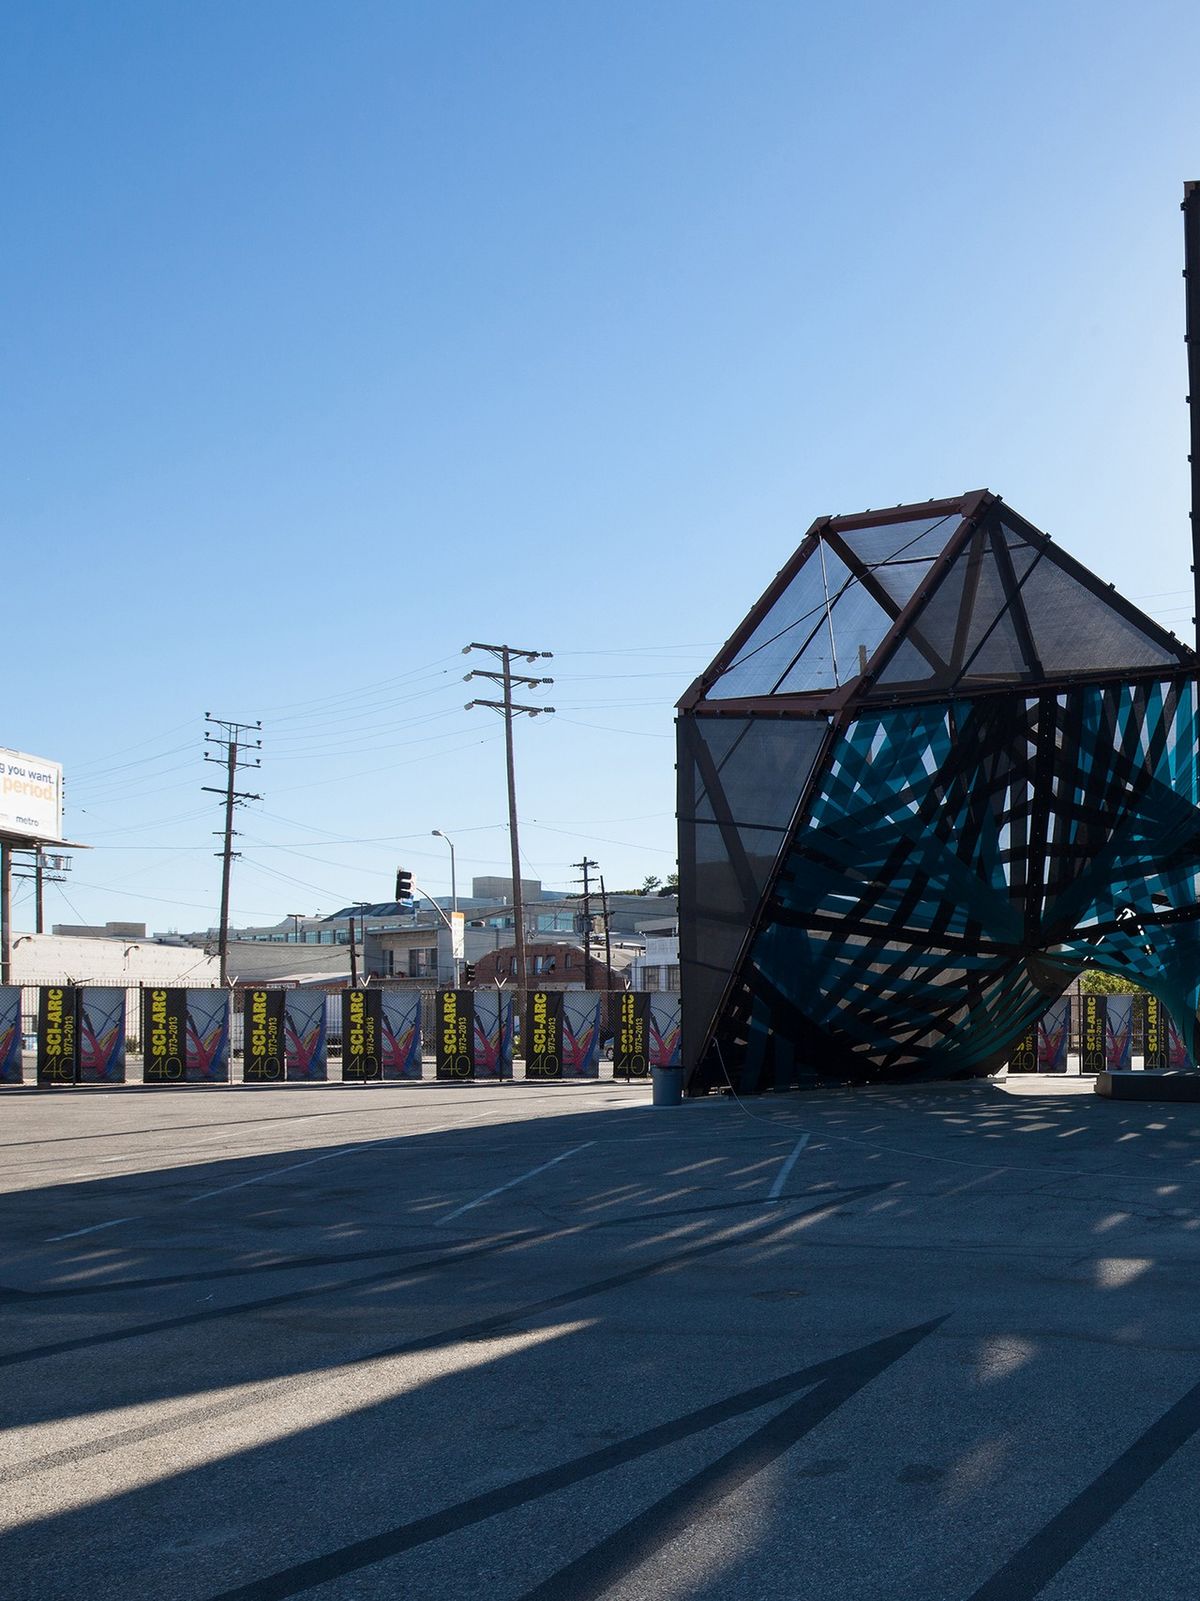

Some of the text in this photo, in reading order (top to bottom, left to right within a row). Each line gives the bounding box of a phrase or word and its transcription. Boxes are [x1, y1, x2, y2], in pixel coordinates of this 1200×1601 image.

[8, 764, 26, 777] you
[28, 770, 54, 785] want.
[46, 989, 63, 1056] SCI-ARC
[64, 1015, 74, 1056] 1973-2013
[152, 990, 167, 1056] SCI-ARC
[169, 1016, 178, 1056] 1973-2013
[252, 991, 267, 1056] SCI-ARC
[268, 1017, 277, 1056] 1973-2013
[350, 991, 364, 1055] SCI-ARC
[443, 992, 457, 1054] SCI-ARC
[533, 992, 547, 1054] SCI-ARC
[548, 1017, 557, 1054] 1973-2013
[1086, 996, 1096, 1051] SCI-ARC
[1147, 996, 1158, 1053] SCI-ARC
[148, 1056, 182, 1079] 40
[248, 1056, 280, 1079] 40
